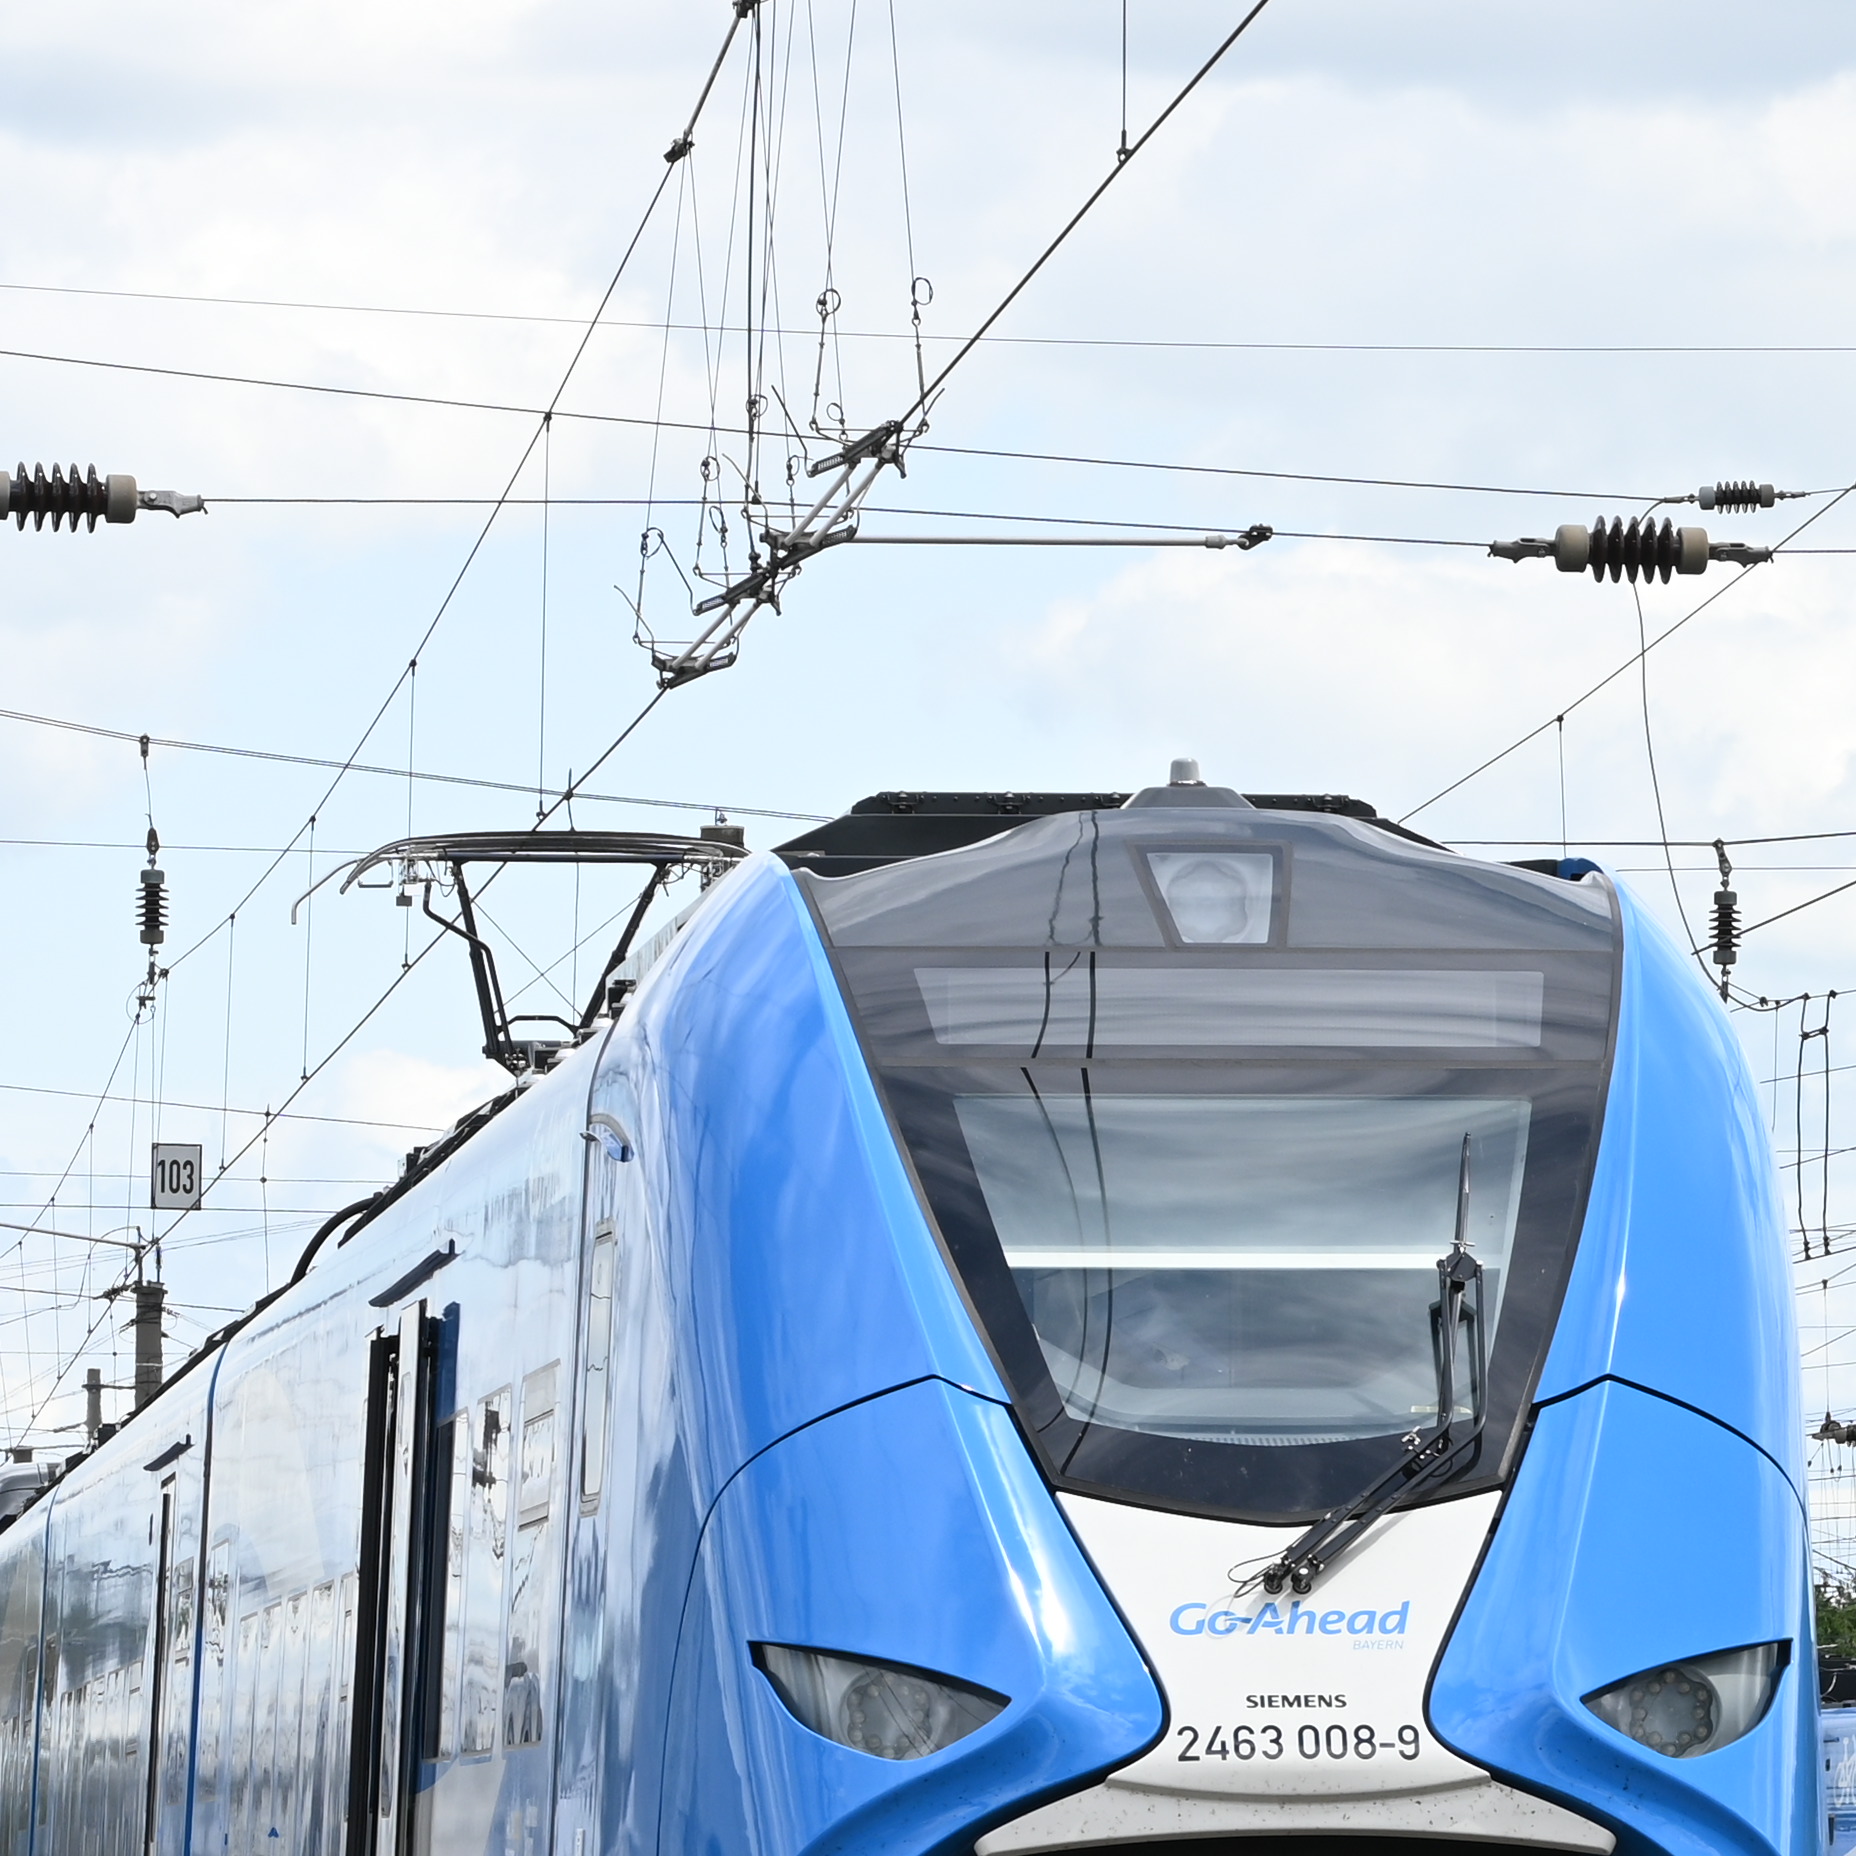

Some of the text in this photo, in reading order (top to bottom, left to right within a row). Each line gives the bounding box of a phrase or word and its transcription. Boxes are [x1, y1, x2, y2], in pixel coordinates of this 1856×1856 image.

[157, 1159, 194, 1195] 103
[1169, 1600, 1410, 1636] Go-Ahead
[1352, 1639, 1405, 1651] BAYERN
[1245, 1693, 1348, 1709] SIEMENS
[1177, 1724, 1421, 1762] 2463 008-9
